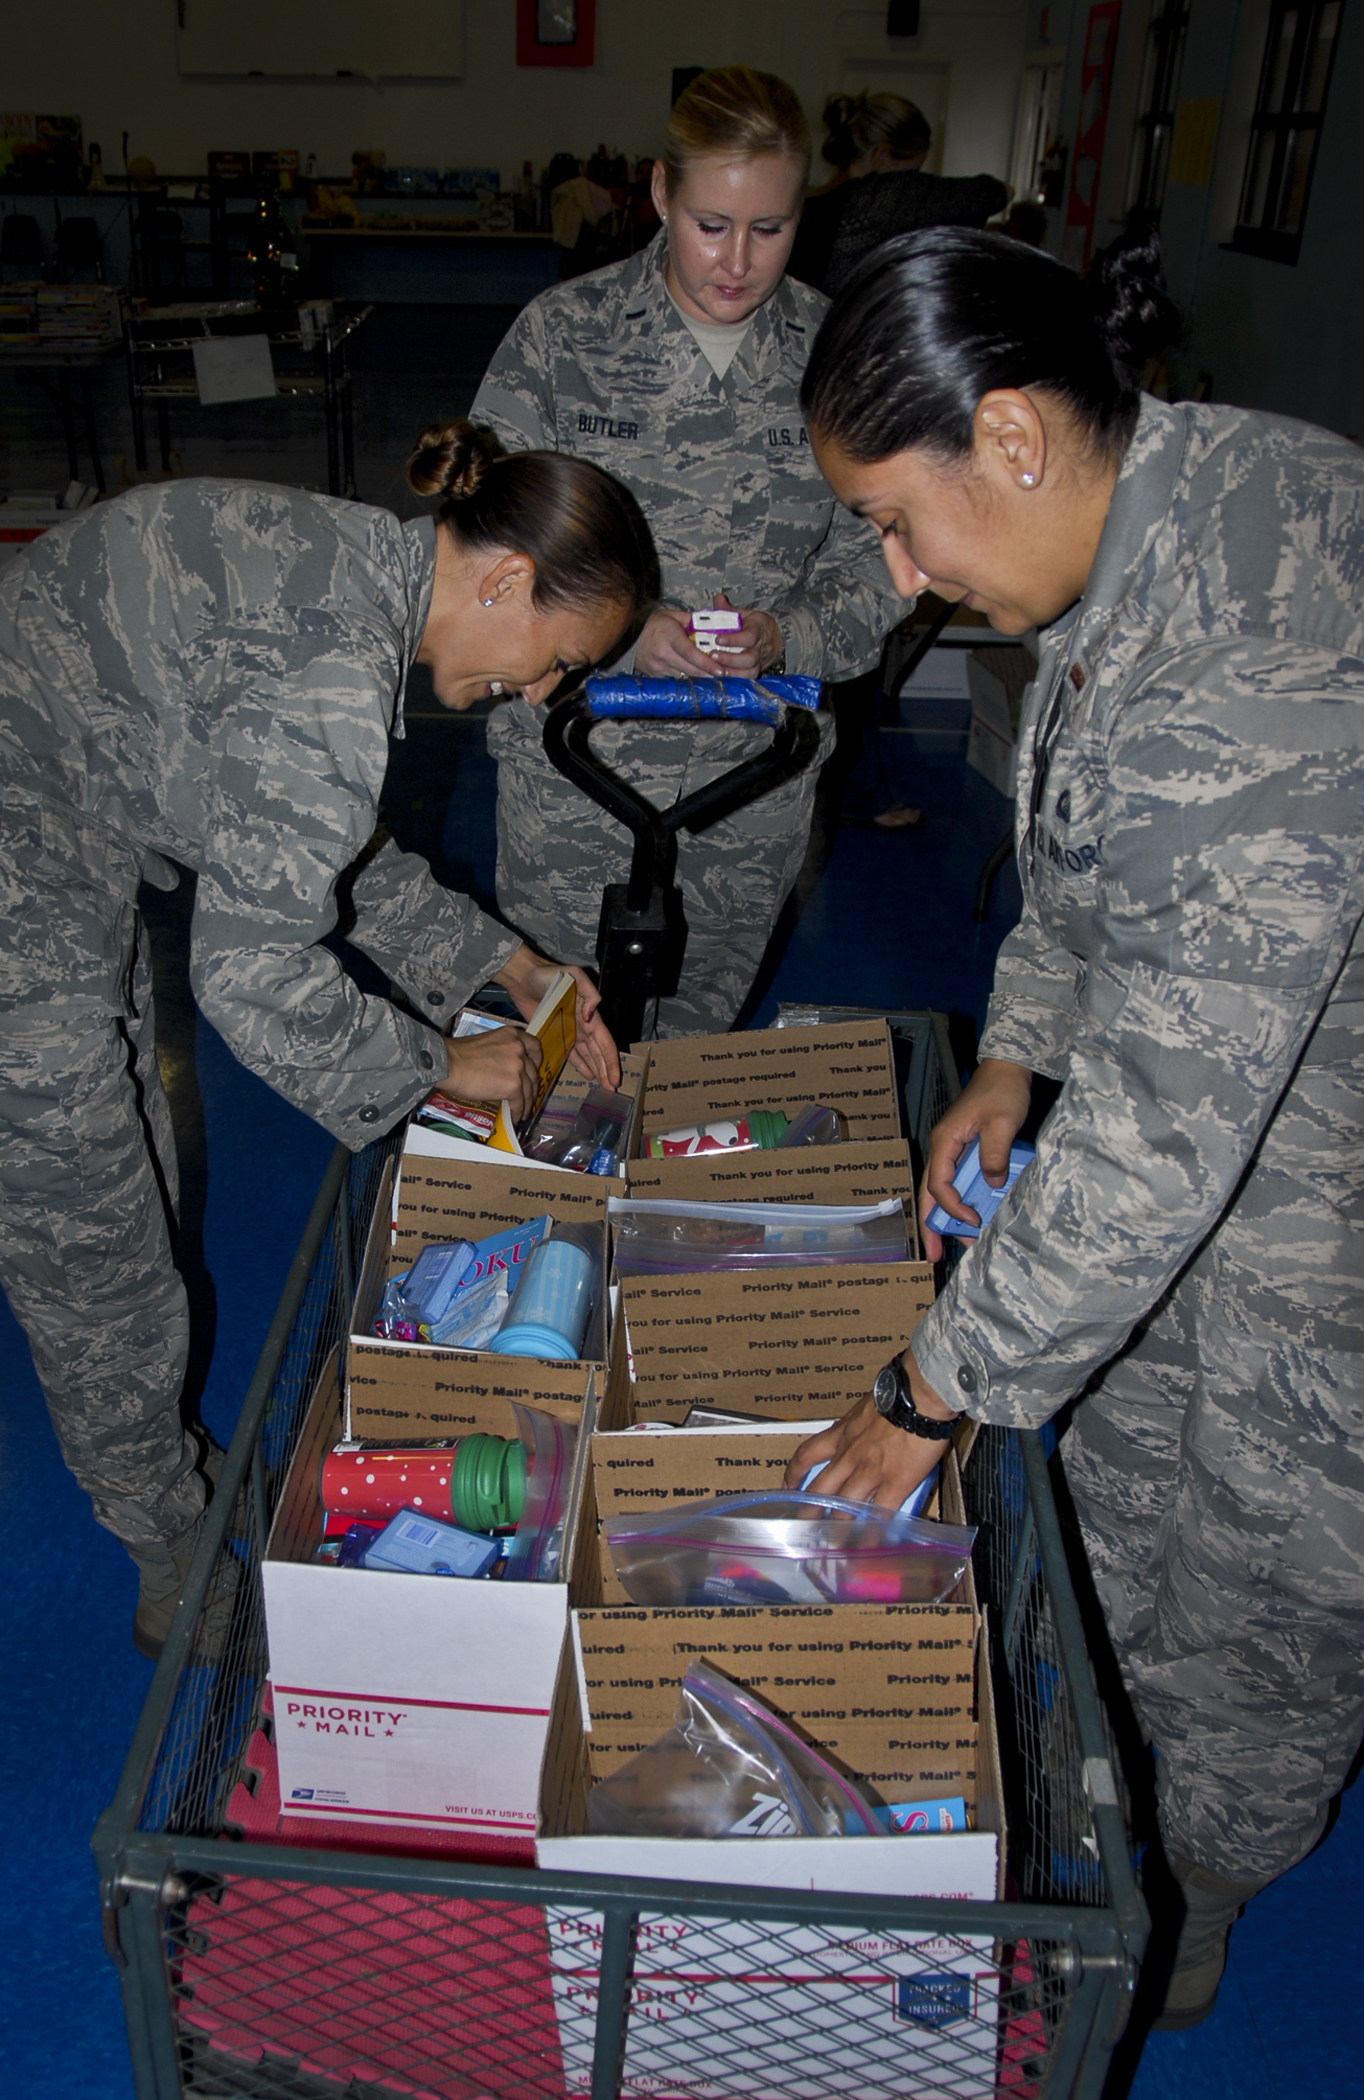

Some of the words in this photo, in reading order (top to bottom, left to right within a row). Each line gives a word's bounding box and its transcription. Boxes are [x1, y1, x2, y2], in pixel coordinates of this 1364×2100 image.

[578, 414, 638, 440] BUTLER
[768, 428, 796, 446] U.S.
[700, 1053, 734, 1062] Thank
[737, 1050, 757, 1059] you
[760, 1048, 776, 1056] for
[780, 1046, 810, 1054] using
[813, 1042, 855, 1052] Priority
[829, 1065, 863, 1074] Thank
[866, 1064, 886, 1073] you
[645, 1084, 668, 1092] ority
[703, 1075, 746, 1087] postage
[749, 1071, 796, 1083] required
[707, 1100, 741, 1109] Thank
[744, 1098, 764, 1107] you
[767, 1096, 783, 1104] for
[786, 1094, 816, 1103] using
[819, 1091, 860, 1100] Priority
[871, 1113, 890, 1121] you
[710, 1172, 747, 1181] Thank
[750, 1171, 772, 1180] you
[776, 1168, 793, 1176] for
[797, 1166, 830, 1175] using
[834, 1163, 879, 1172] Priority
[425, 1178, 472, 1190] Service
[629, 1178, 661, 1187] uired
[509, 1187, 556, 1201] Priority
[851, 1186, 888, 1197] Thank
[421, 1204, 439, 1214] for
[442, 1208, 476, 1219] using
[480, 1211, 525, 1225] Priority
[391, 1254, 413, 1264] you
[459, 1235, 540, 1287] OKU
[650, 1288, 702, 1298] Service
[742, 1283, 793, 1293] Priority
[652, 1318, 671, 1326] for
[675, 1316, 712, 1325] using
[716, 1313, 766, 1323] Priority
[809, 1308, 861, 1318] Service
[658, 1345, 709, 1354] Service
[748, 1339, 799, 1349] Priority
[356, 1346, 411, 1358] postage
[660, 1373, 679, 1381] for
[683, 1371, 719, 1380] using
[723, 1368, 772, 1378] Priority
[814, 1363, 865, 1374] Service
[435, 1382, 488, 1396] Priority
[534, 1391, 584, 1403] postag
[754, 1393, 804, 1403] Priority
[666, 1396, 715, 1407] Service
[715, 1457, 761, 1467] Thank
[766, 1458, 791, 1468] you
[614, 1488, 668, 1498] Priority
[602, 1610, 647, 1621] using
[653, 1608, 715, 1620] Priority
[769, 1607, 833, 1618] Service
[885, 1605, 950, 1616] Priority
[582, 1644, 625, 1654] uired
[676, 1642, 728, 1653] Thank
[733, 1644, 762, 1654] you
[768, 1642, 793, 1652] for
[798, 1641, 843, 1653] using
[849, 1640, 912, 1652] Priority
[610, 1678, 654, 1689] using
[774, 1676, 836, 1686] Service
[887, 1674, 950, 1685] Priority
[590, 1711, 633, 1720] uired
[801, 1707, 846, 1719] using
[851, 1707, 913, 1719] Priority
[315, 1722, 375, 1737] MAIL
[589, 1743, 612, 1752] for
[888, 1740, 950, 1751] Priority
[853, 1771, 914, 1782] Priority
[445, 1805, 468, 1814] VISIT
